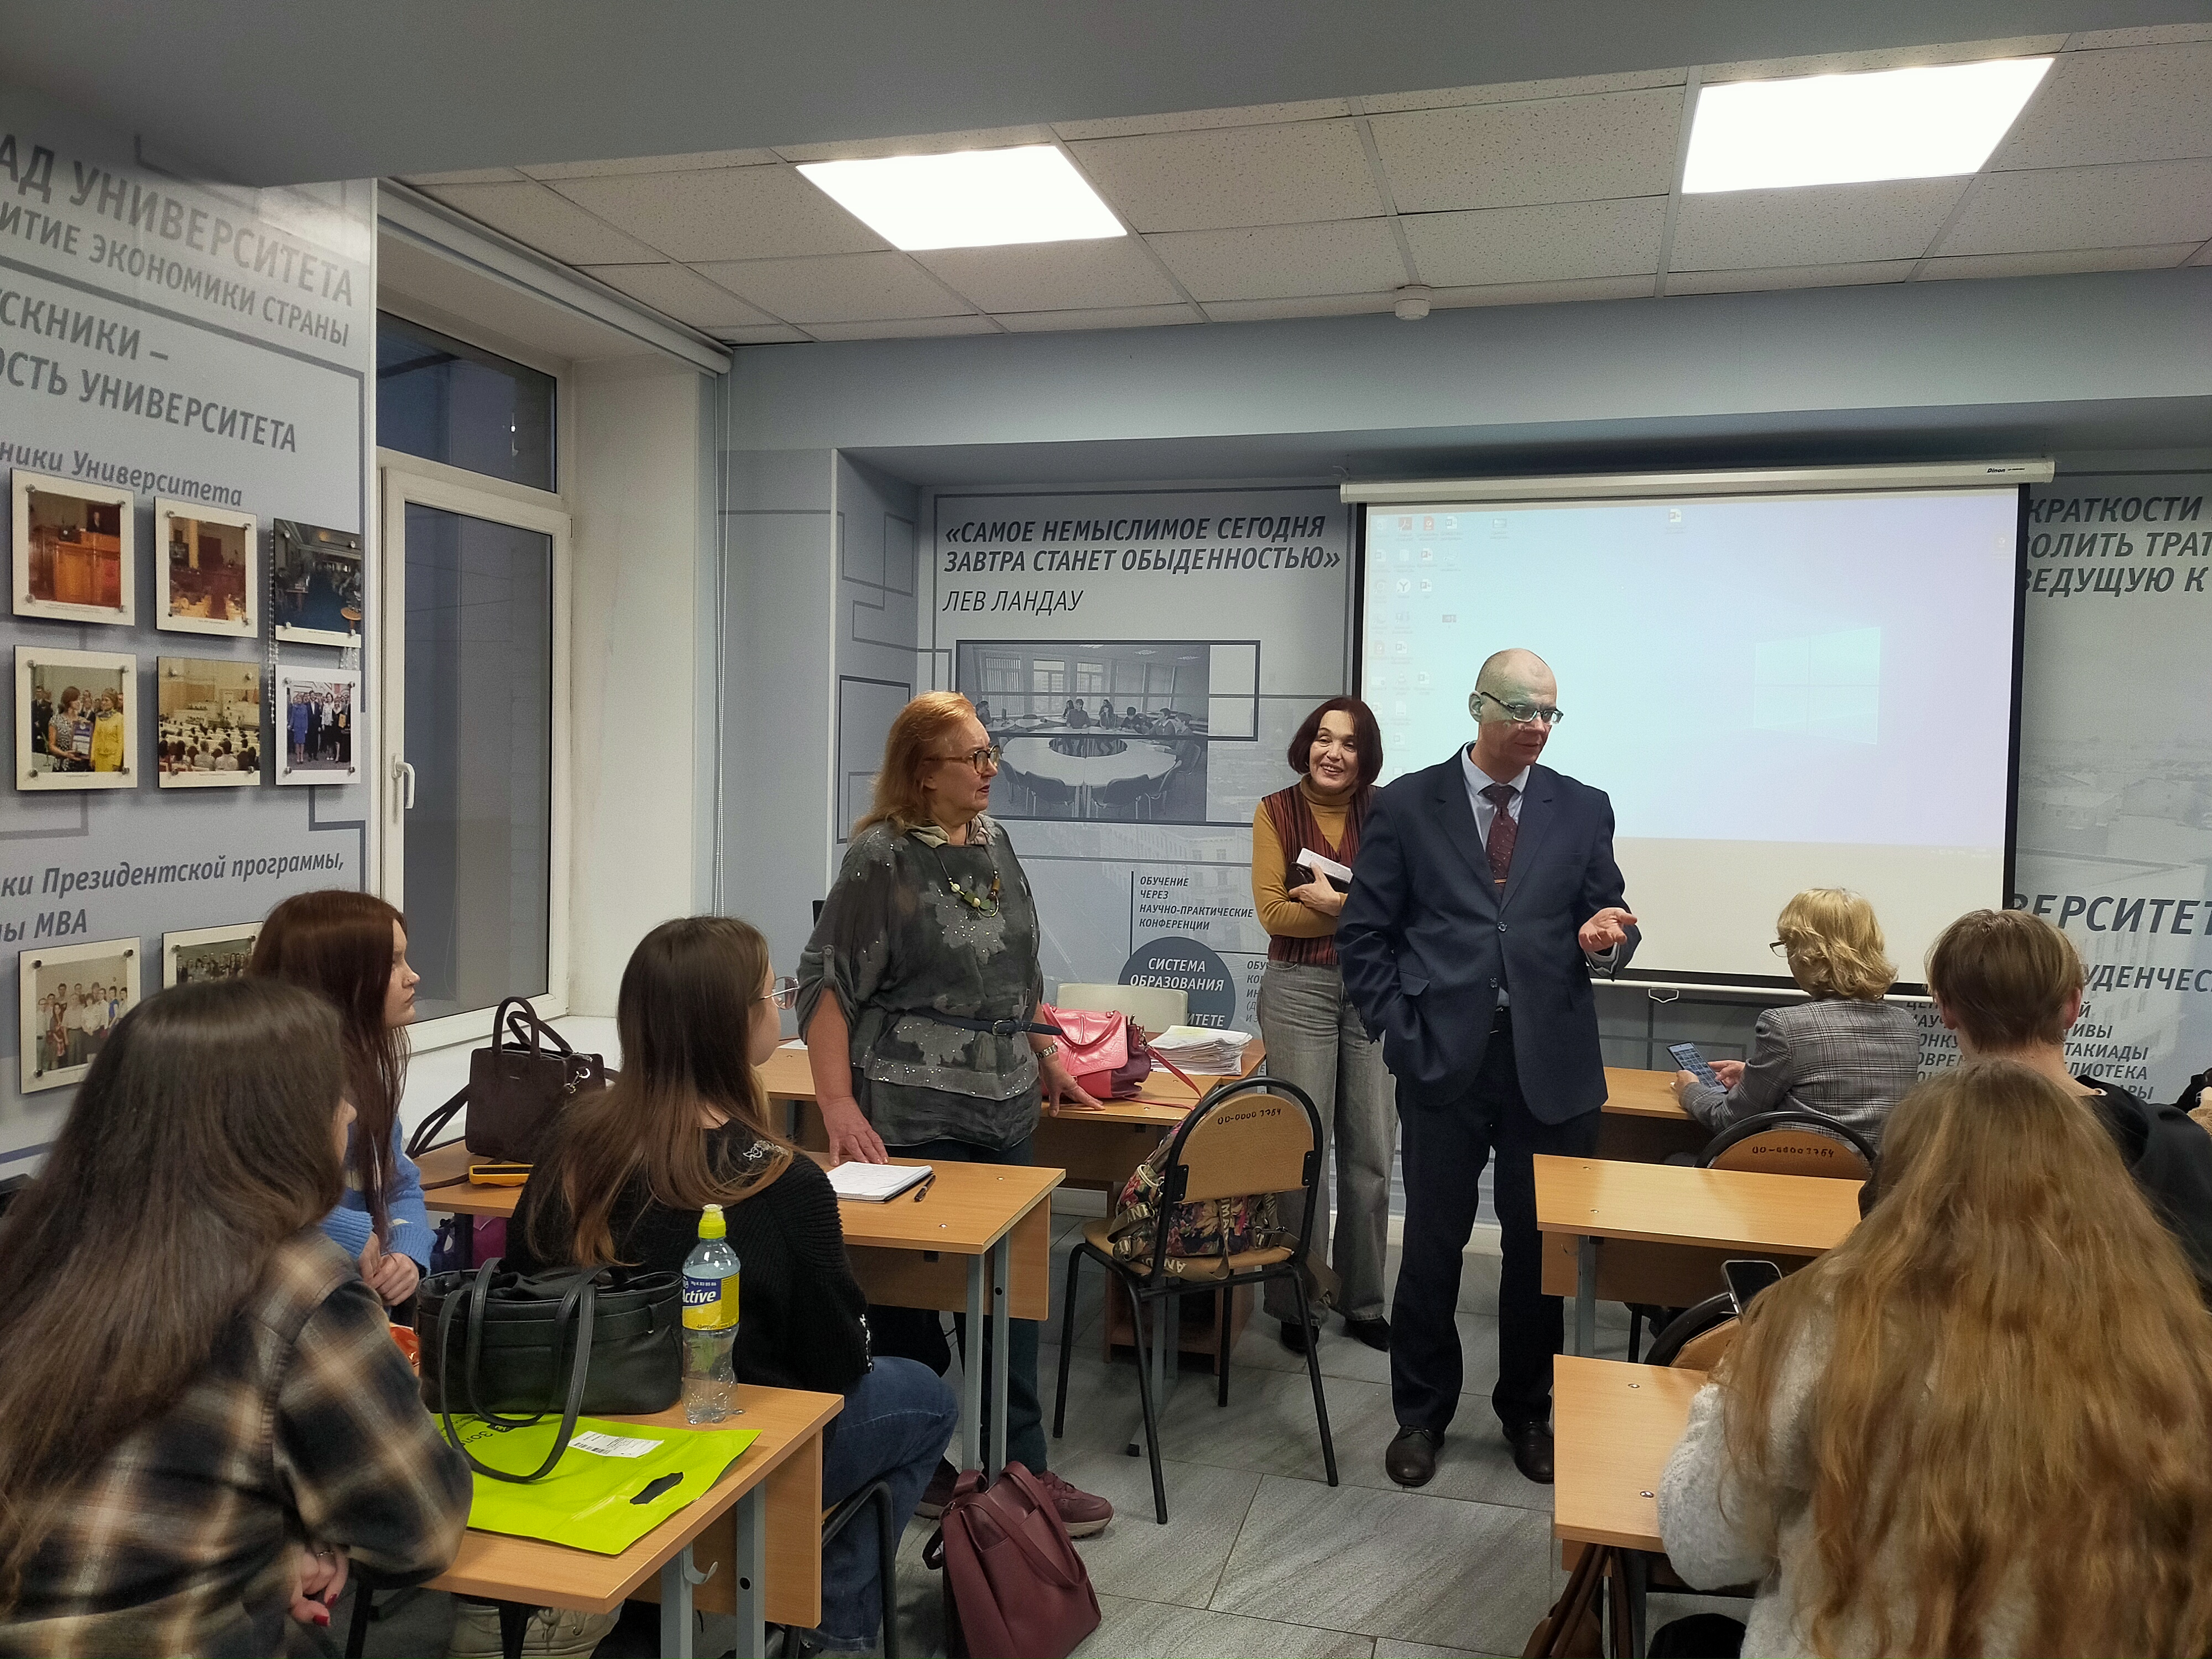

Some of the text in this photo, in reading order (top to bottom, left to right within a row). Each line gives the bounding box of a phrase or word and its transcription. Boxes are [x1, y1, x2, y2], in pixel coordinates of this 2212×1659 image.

[69, 160, 353, 307] УНИВЕРСИТЕТА
[88, 233, 256, 316] ЭКОНОМИКИ
[262, 295, 349, 347] СТРАНЫ
[0, 289, 142, 361] СКНИКИ
[79, 369, 297, 452] УНИВЕРСИТЕТА
[72, 450, 242, 507] Университета
[946, 515, 1326, 543] «САМОЕ НЕМЫСЛИМОЕ СЕГОДНЯ
[2027, 533, 2134, 559] ОЛИТЬ
[944, 546, 1341, 575] ЗАВТРА СТАНЕТ ОБЫДЕННОСТЬЮ»
[942, 589, 1084, 615] ЛЕВ ЛАНДАУ
[43, 854, 226, 900] Президентской
[231, 852, 345, 882] программы,
[1140, 877, 1189, 886] ОБУЧЕНИЕ
[1140, 890, 1169, 899] ЧЕРЕЗ
[1139, 904, 1254, 917] НАУЧНО-ПРАКТИЧЕСКИЕ
[2015, 893, 2212, 936] ЕРСИТЕ
[0, 921, 25, 942] ы
[1139, 918, 1210, 931] КОНФЕРЕНЦИИ
[1148, 957, 1206, 972] СИСТЕМА
[1130, 974, 1224, 991] ОБРАЗОВАНИЯ
[1246, 974, 1263, 984] КО
[2065, 1023, 2113, 1039] ИВЫ
[2065, 1061, 2148, 1080] ЛИОТЕКА
[2120, 1084, 2154, 1100] РЫ
